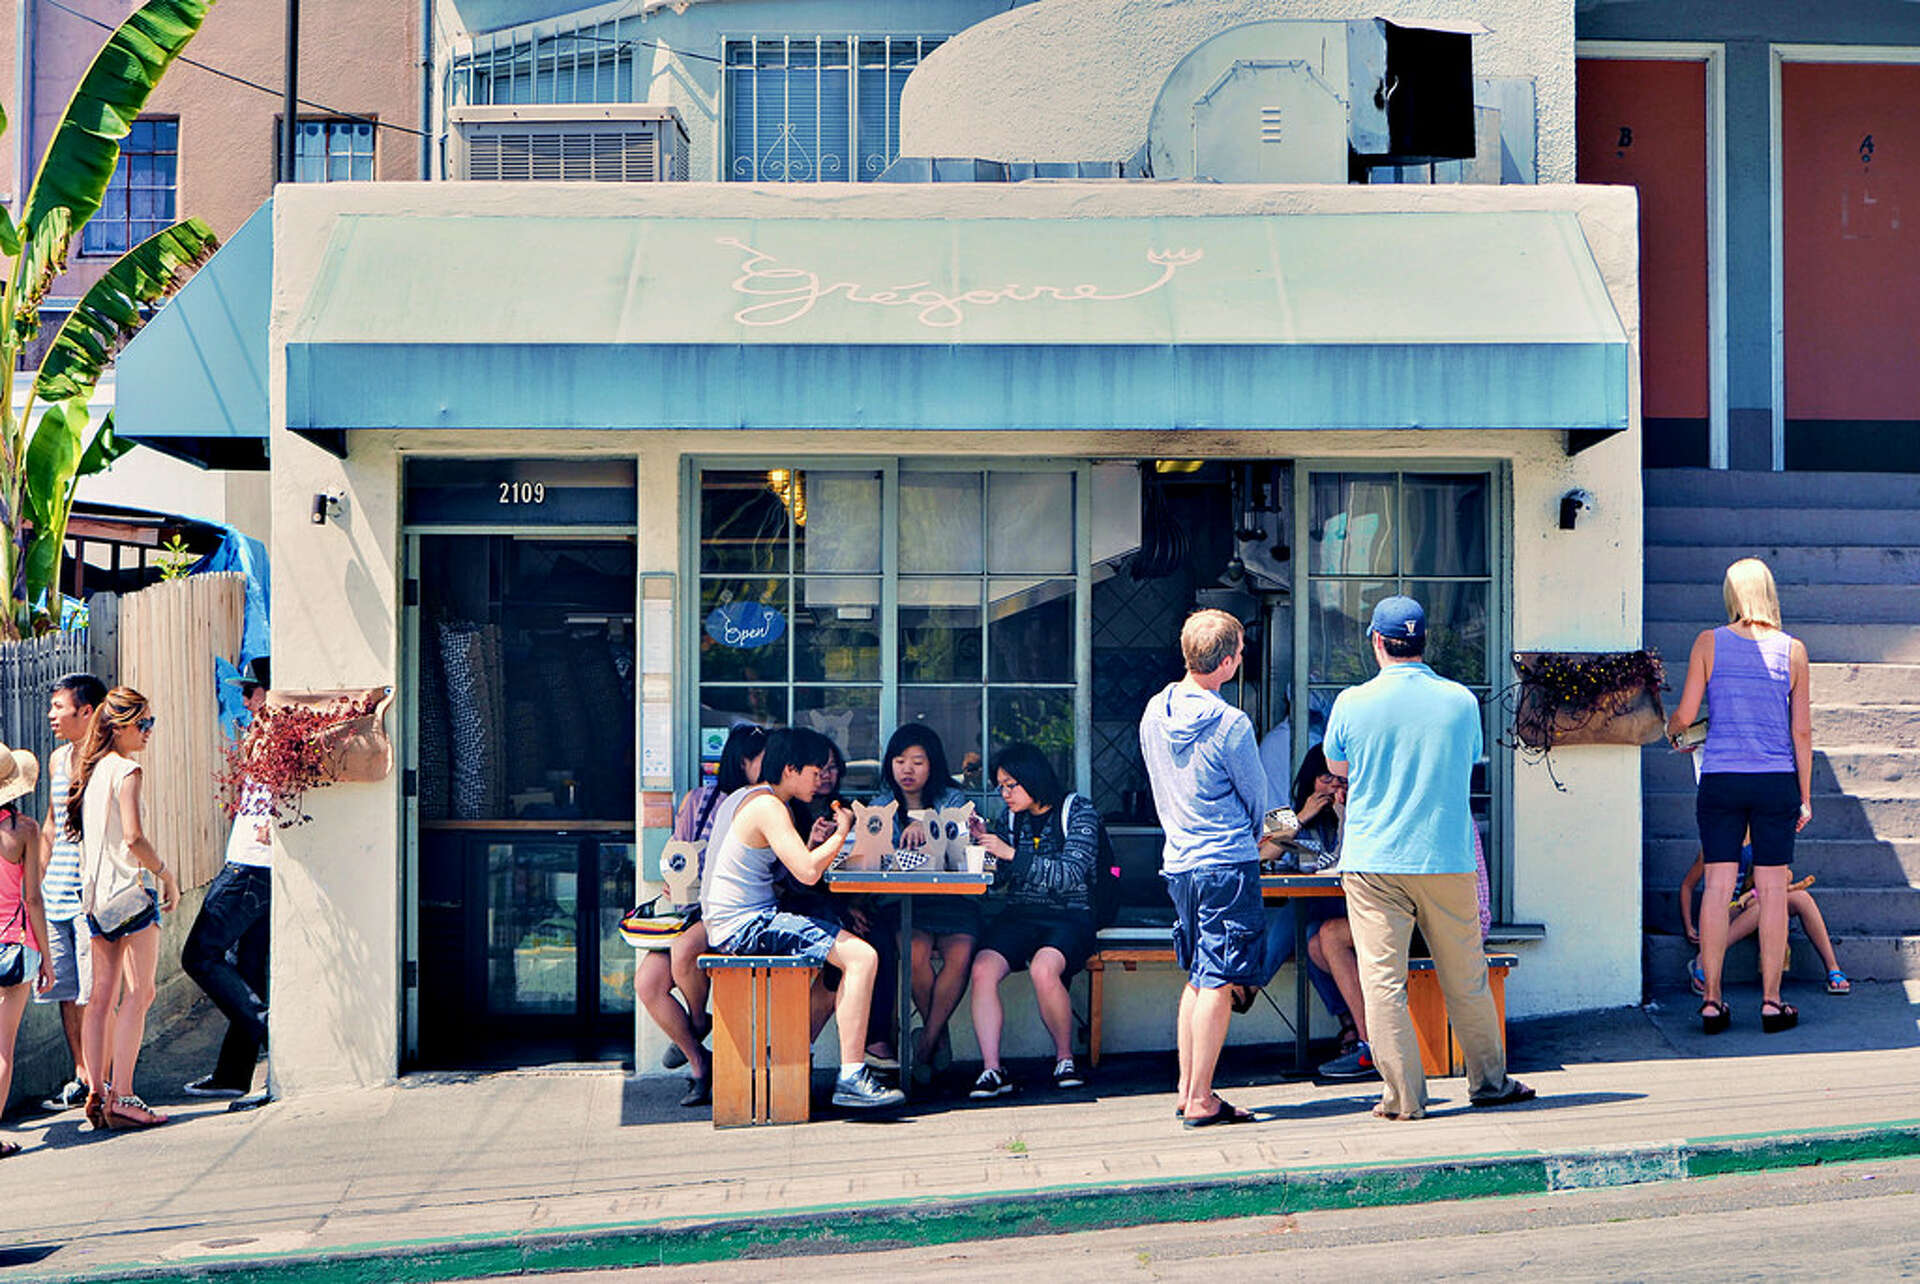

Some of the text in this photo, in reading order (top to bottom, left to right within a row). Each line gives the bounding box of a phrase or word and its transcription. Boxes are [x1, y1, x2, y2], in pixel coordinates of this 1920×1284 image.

[1618, 126, 1632, 147] B
[1859, 134, 1874, 153] A
[719, 238, 1202, 327] Grégoire
[499, 482, 545, 503] 2109
[721, 612, 773, 647] Open
